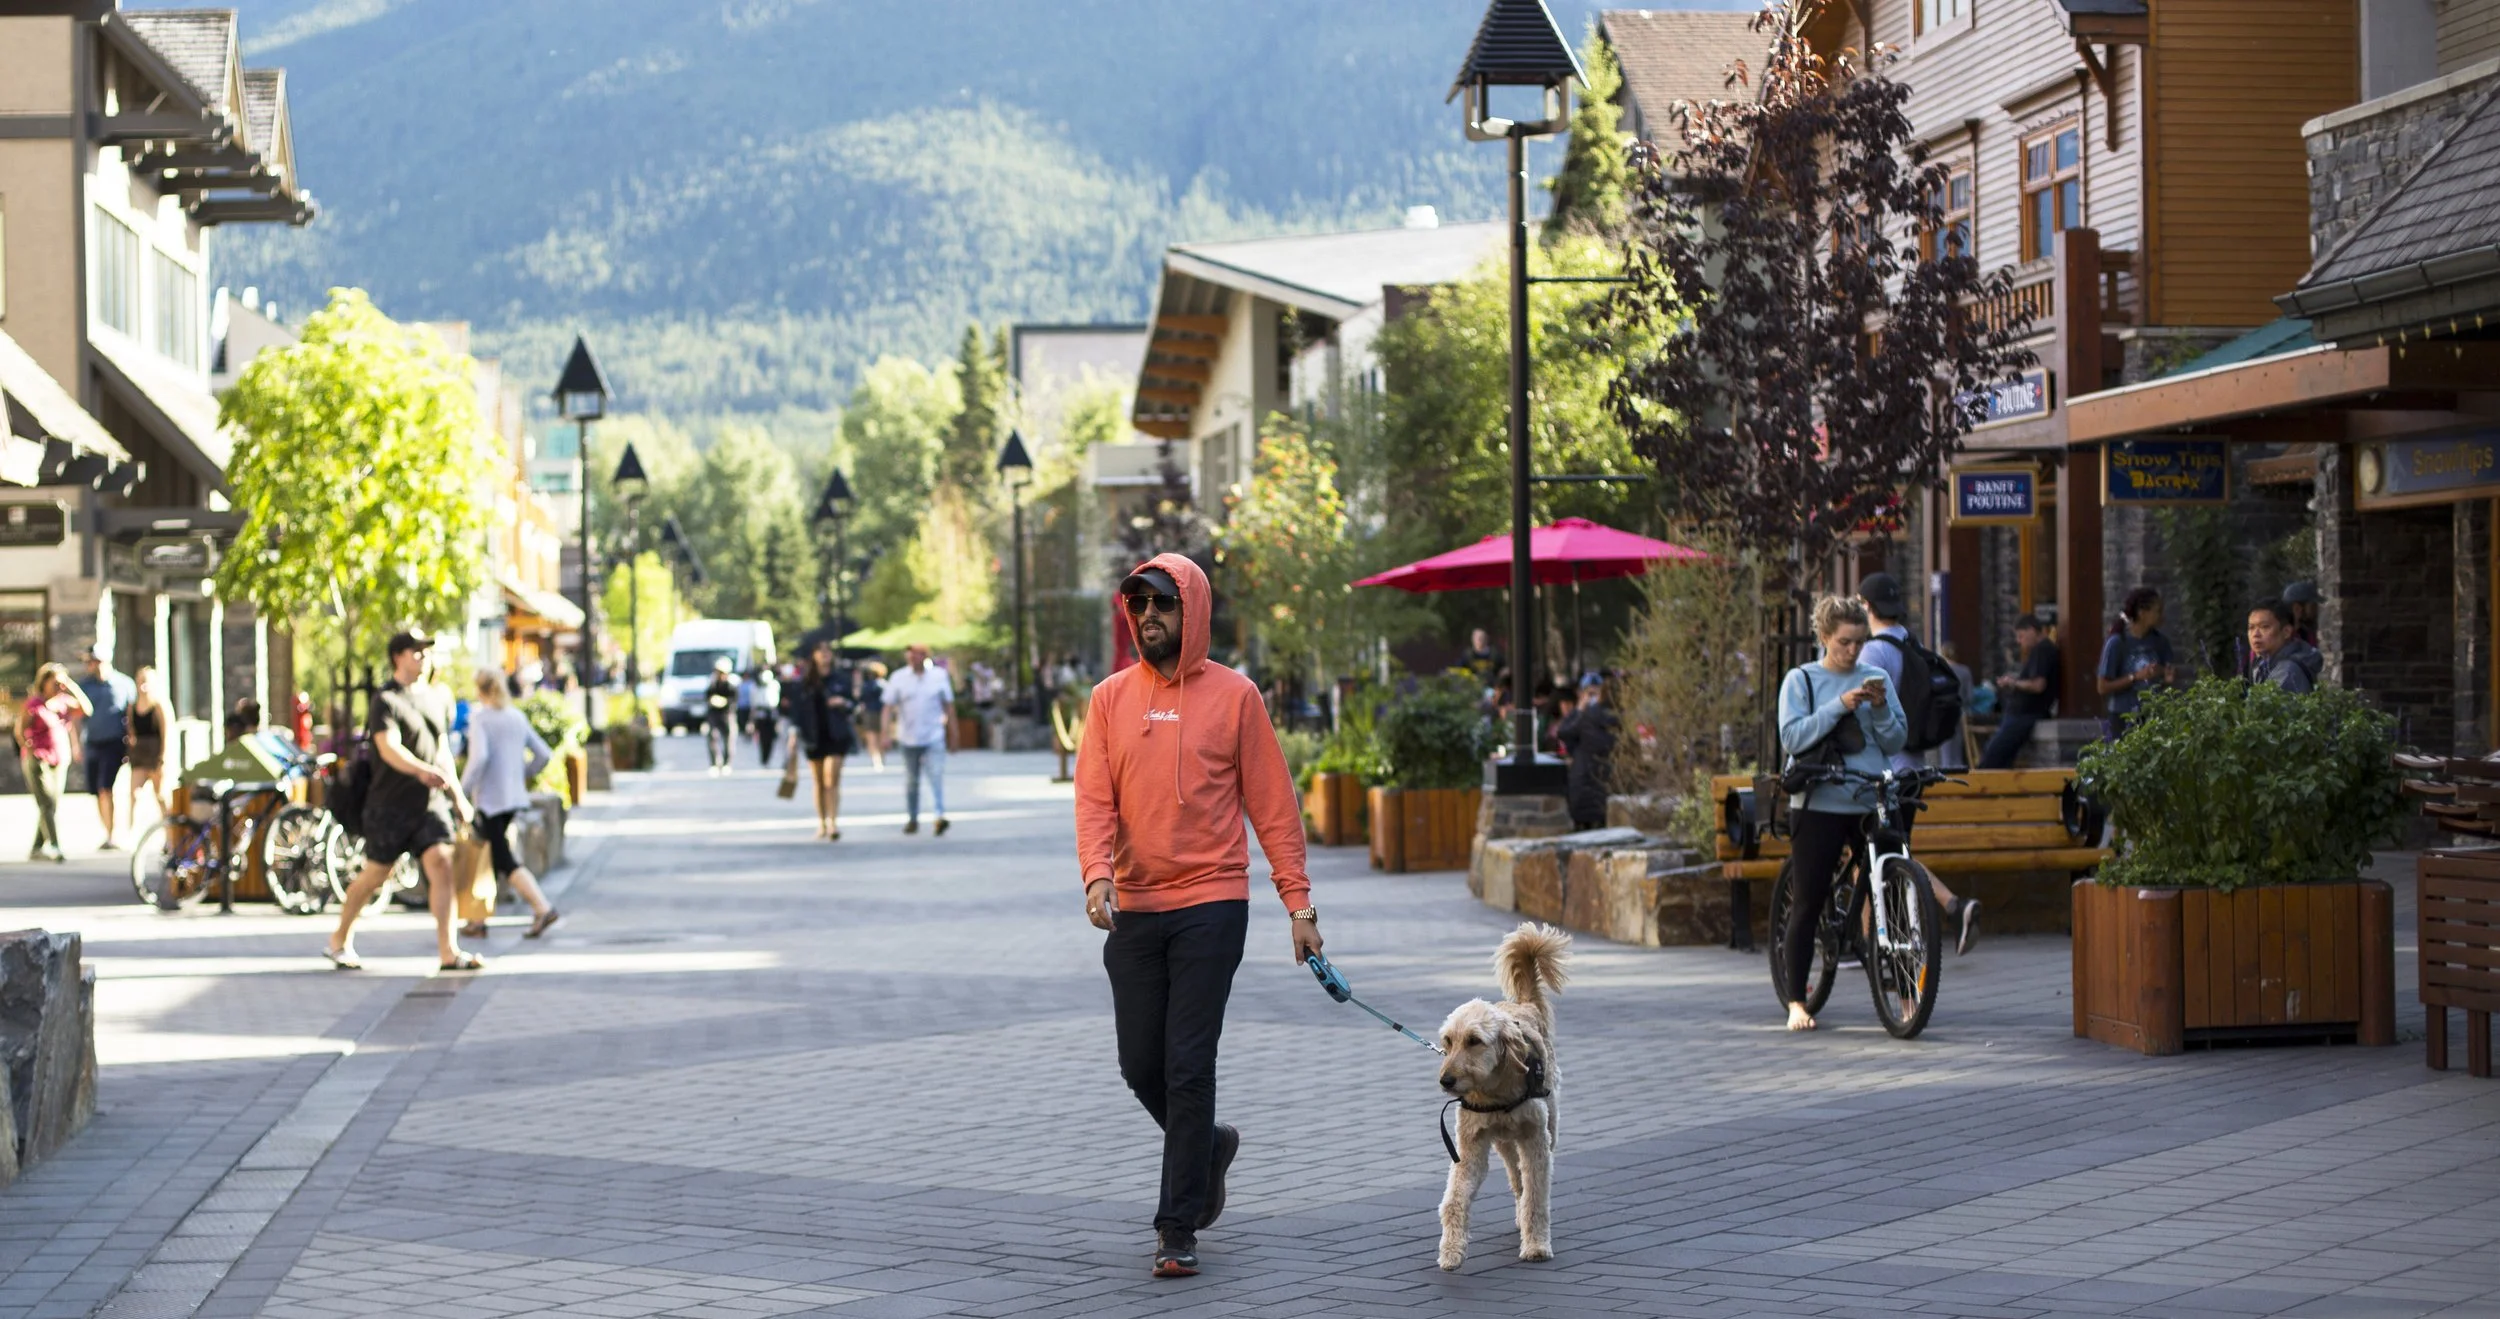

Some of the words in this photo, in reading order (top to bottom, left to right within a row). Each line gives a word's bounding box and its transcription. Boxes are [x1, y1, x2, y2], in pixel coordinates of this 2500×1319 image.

[2112, 450, 2172, 467] Snow
[2177, 451, 2221, 469] Tips
[1966, 493, 2026, 511] POUTINE
